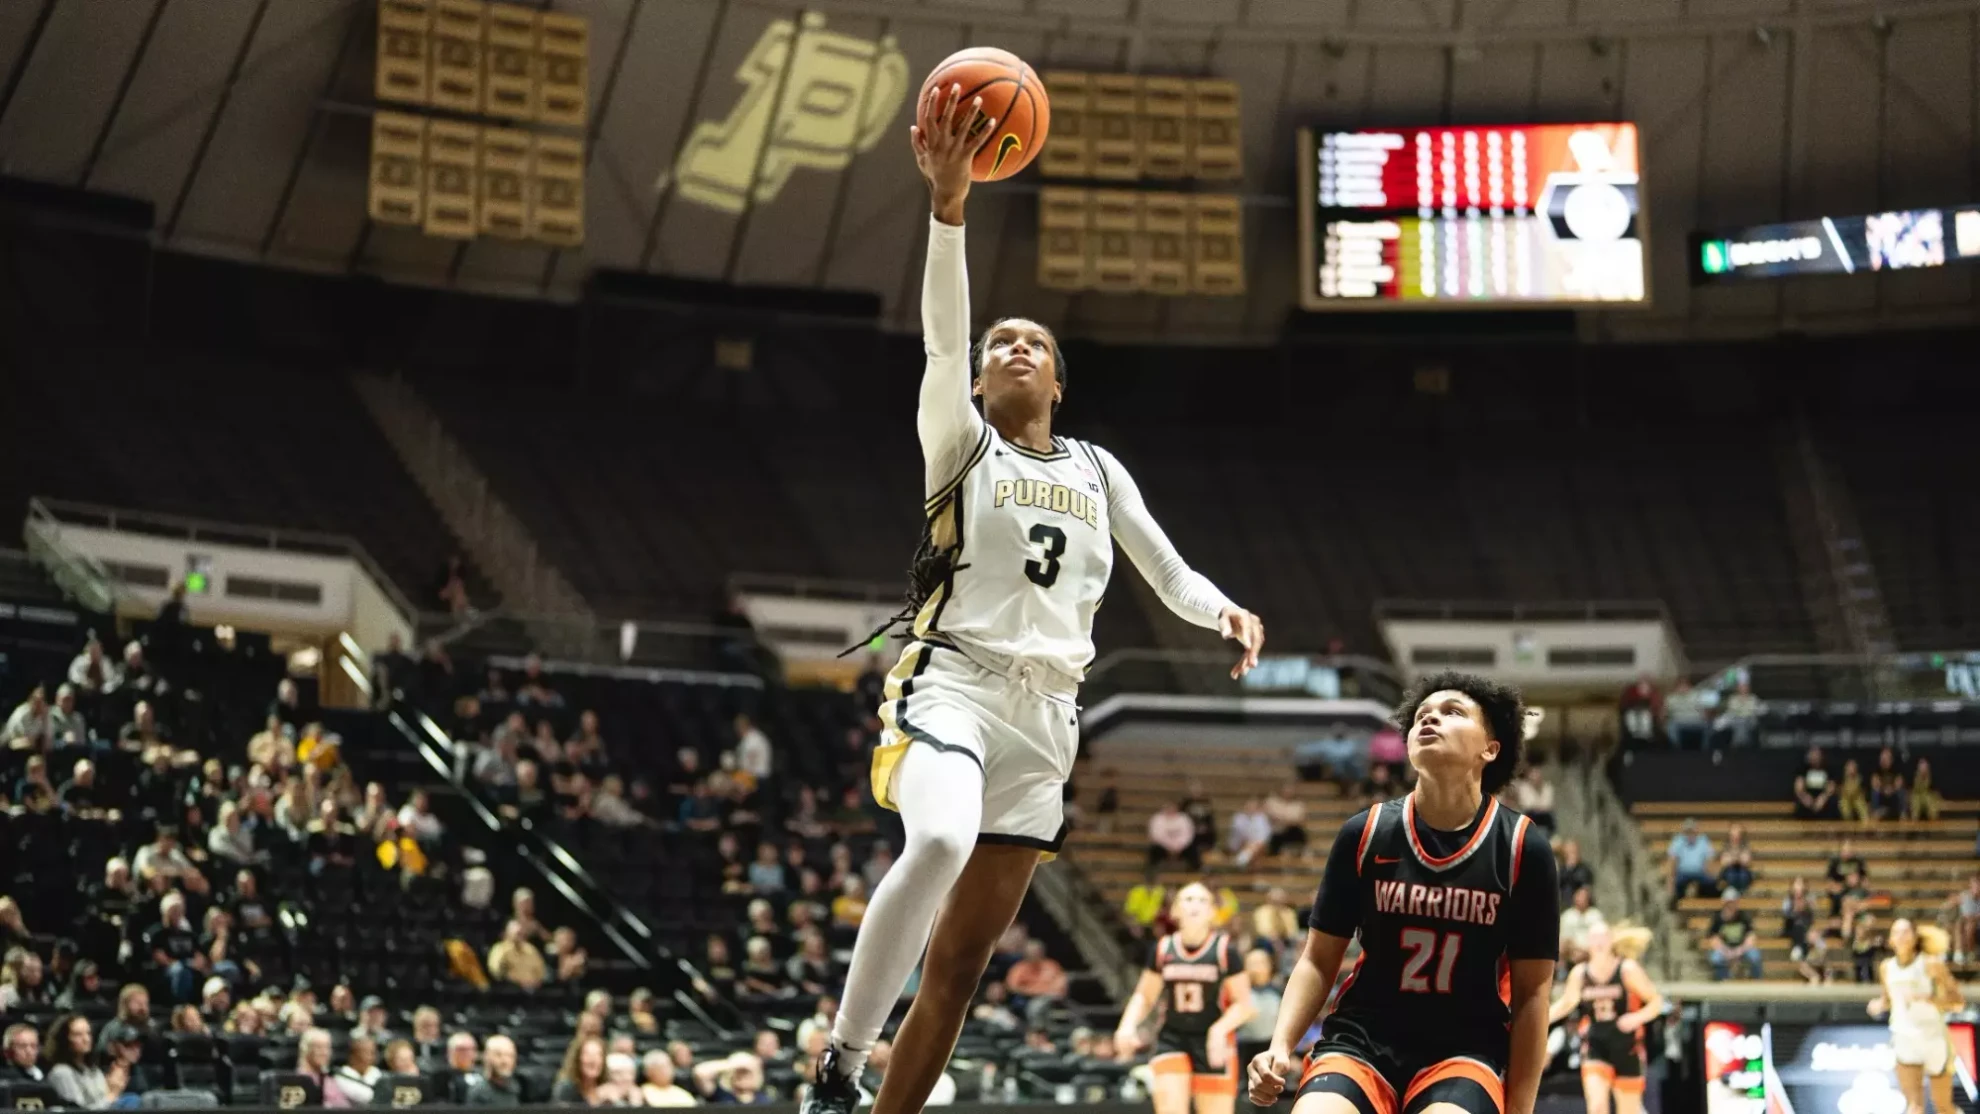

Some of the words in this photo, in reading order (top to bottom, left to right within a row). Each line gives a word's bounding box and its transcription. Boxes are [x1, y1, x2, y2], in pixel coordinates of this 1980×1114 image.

[994, 478, 1098, 531] PURDUE
[1024, 523, 1067, 589] 3
[1374, 879, 1501, 926] WARRIORS
[1399, 926, 1463, 994] 21
